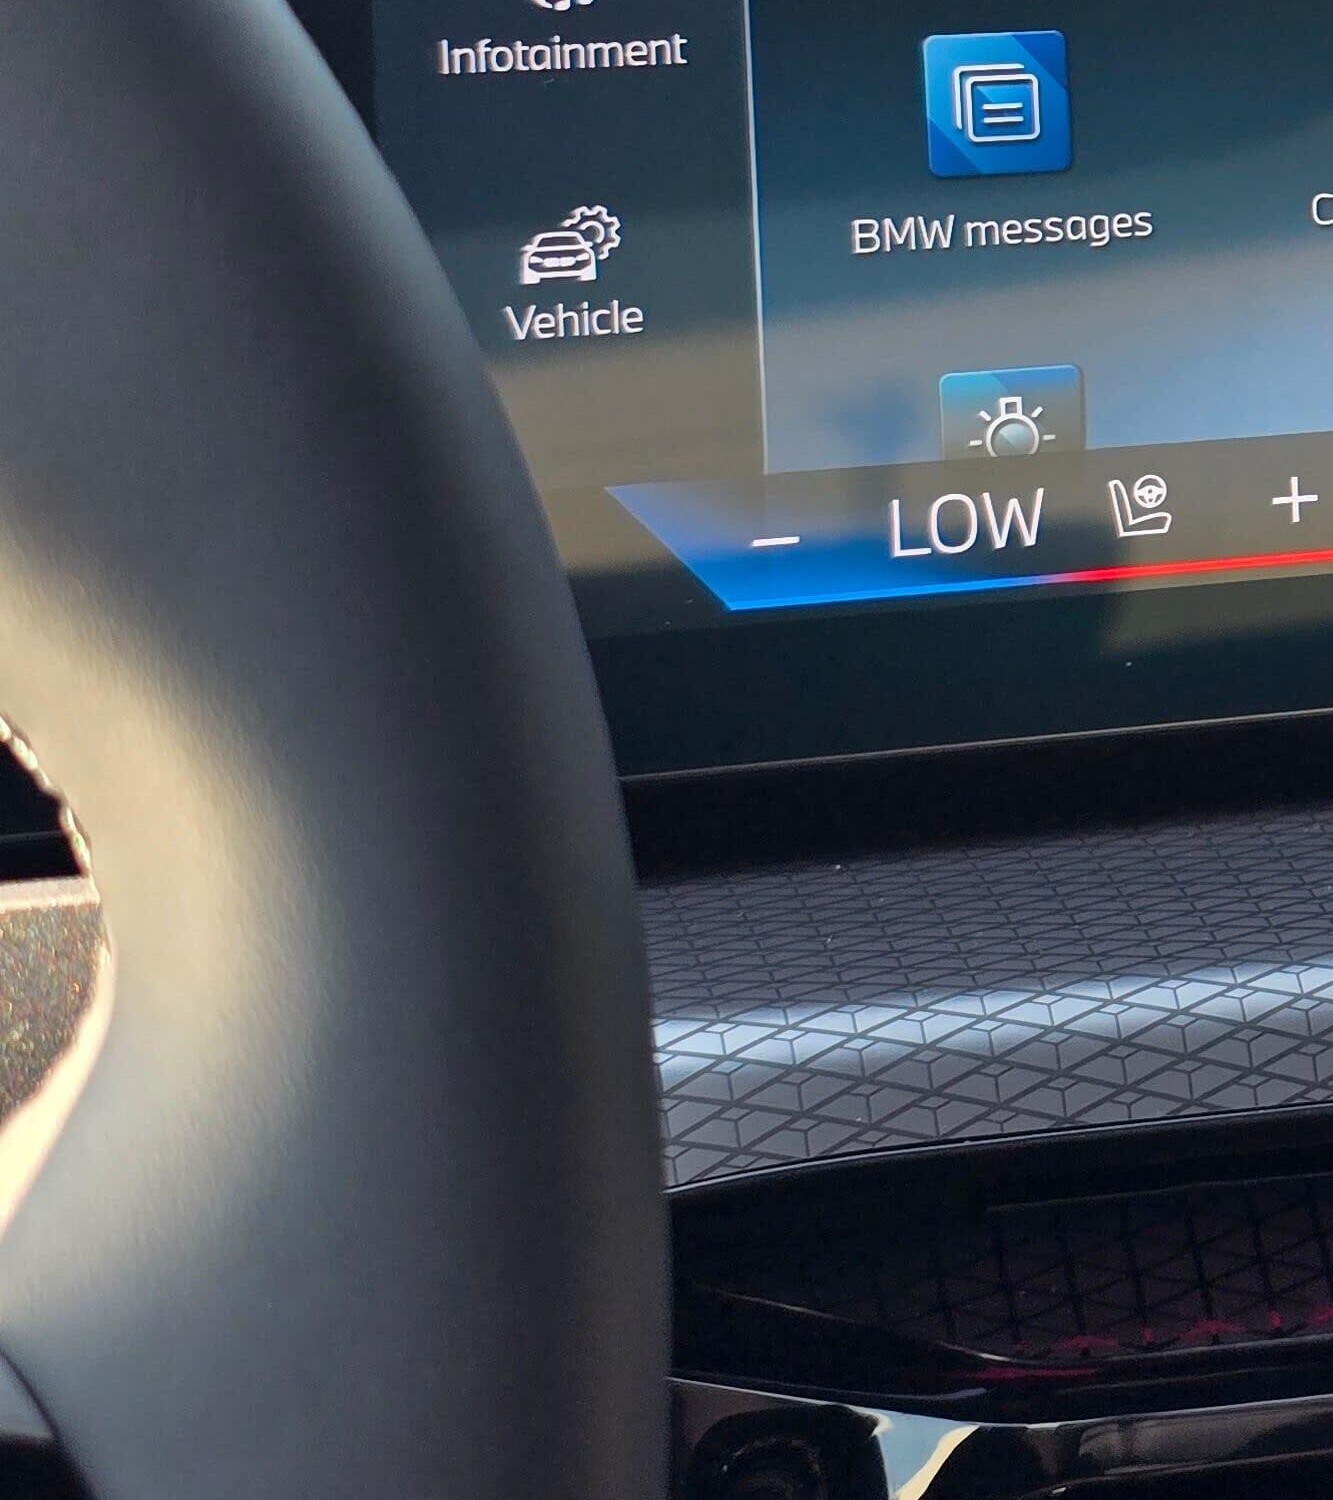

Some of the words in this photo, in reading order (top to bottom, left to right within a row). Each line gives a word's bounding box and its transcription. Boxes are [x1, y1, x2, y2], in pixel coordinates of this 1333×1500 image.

[440, 33, 688, 75] Infotainment
[851, 214, 955, 254] BMW
[966, 211, 1153, 247] messages
[503, 299, 644, 340] Vehicle
[891, 487, 1044, 557] LOW
